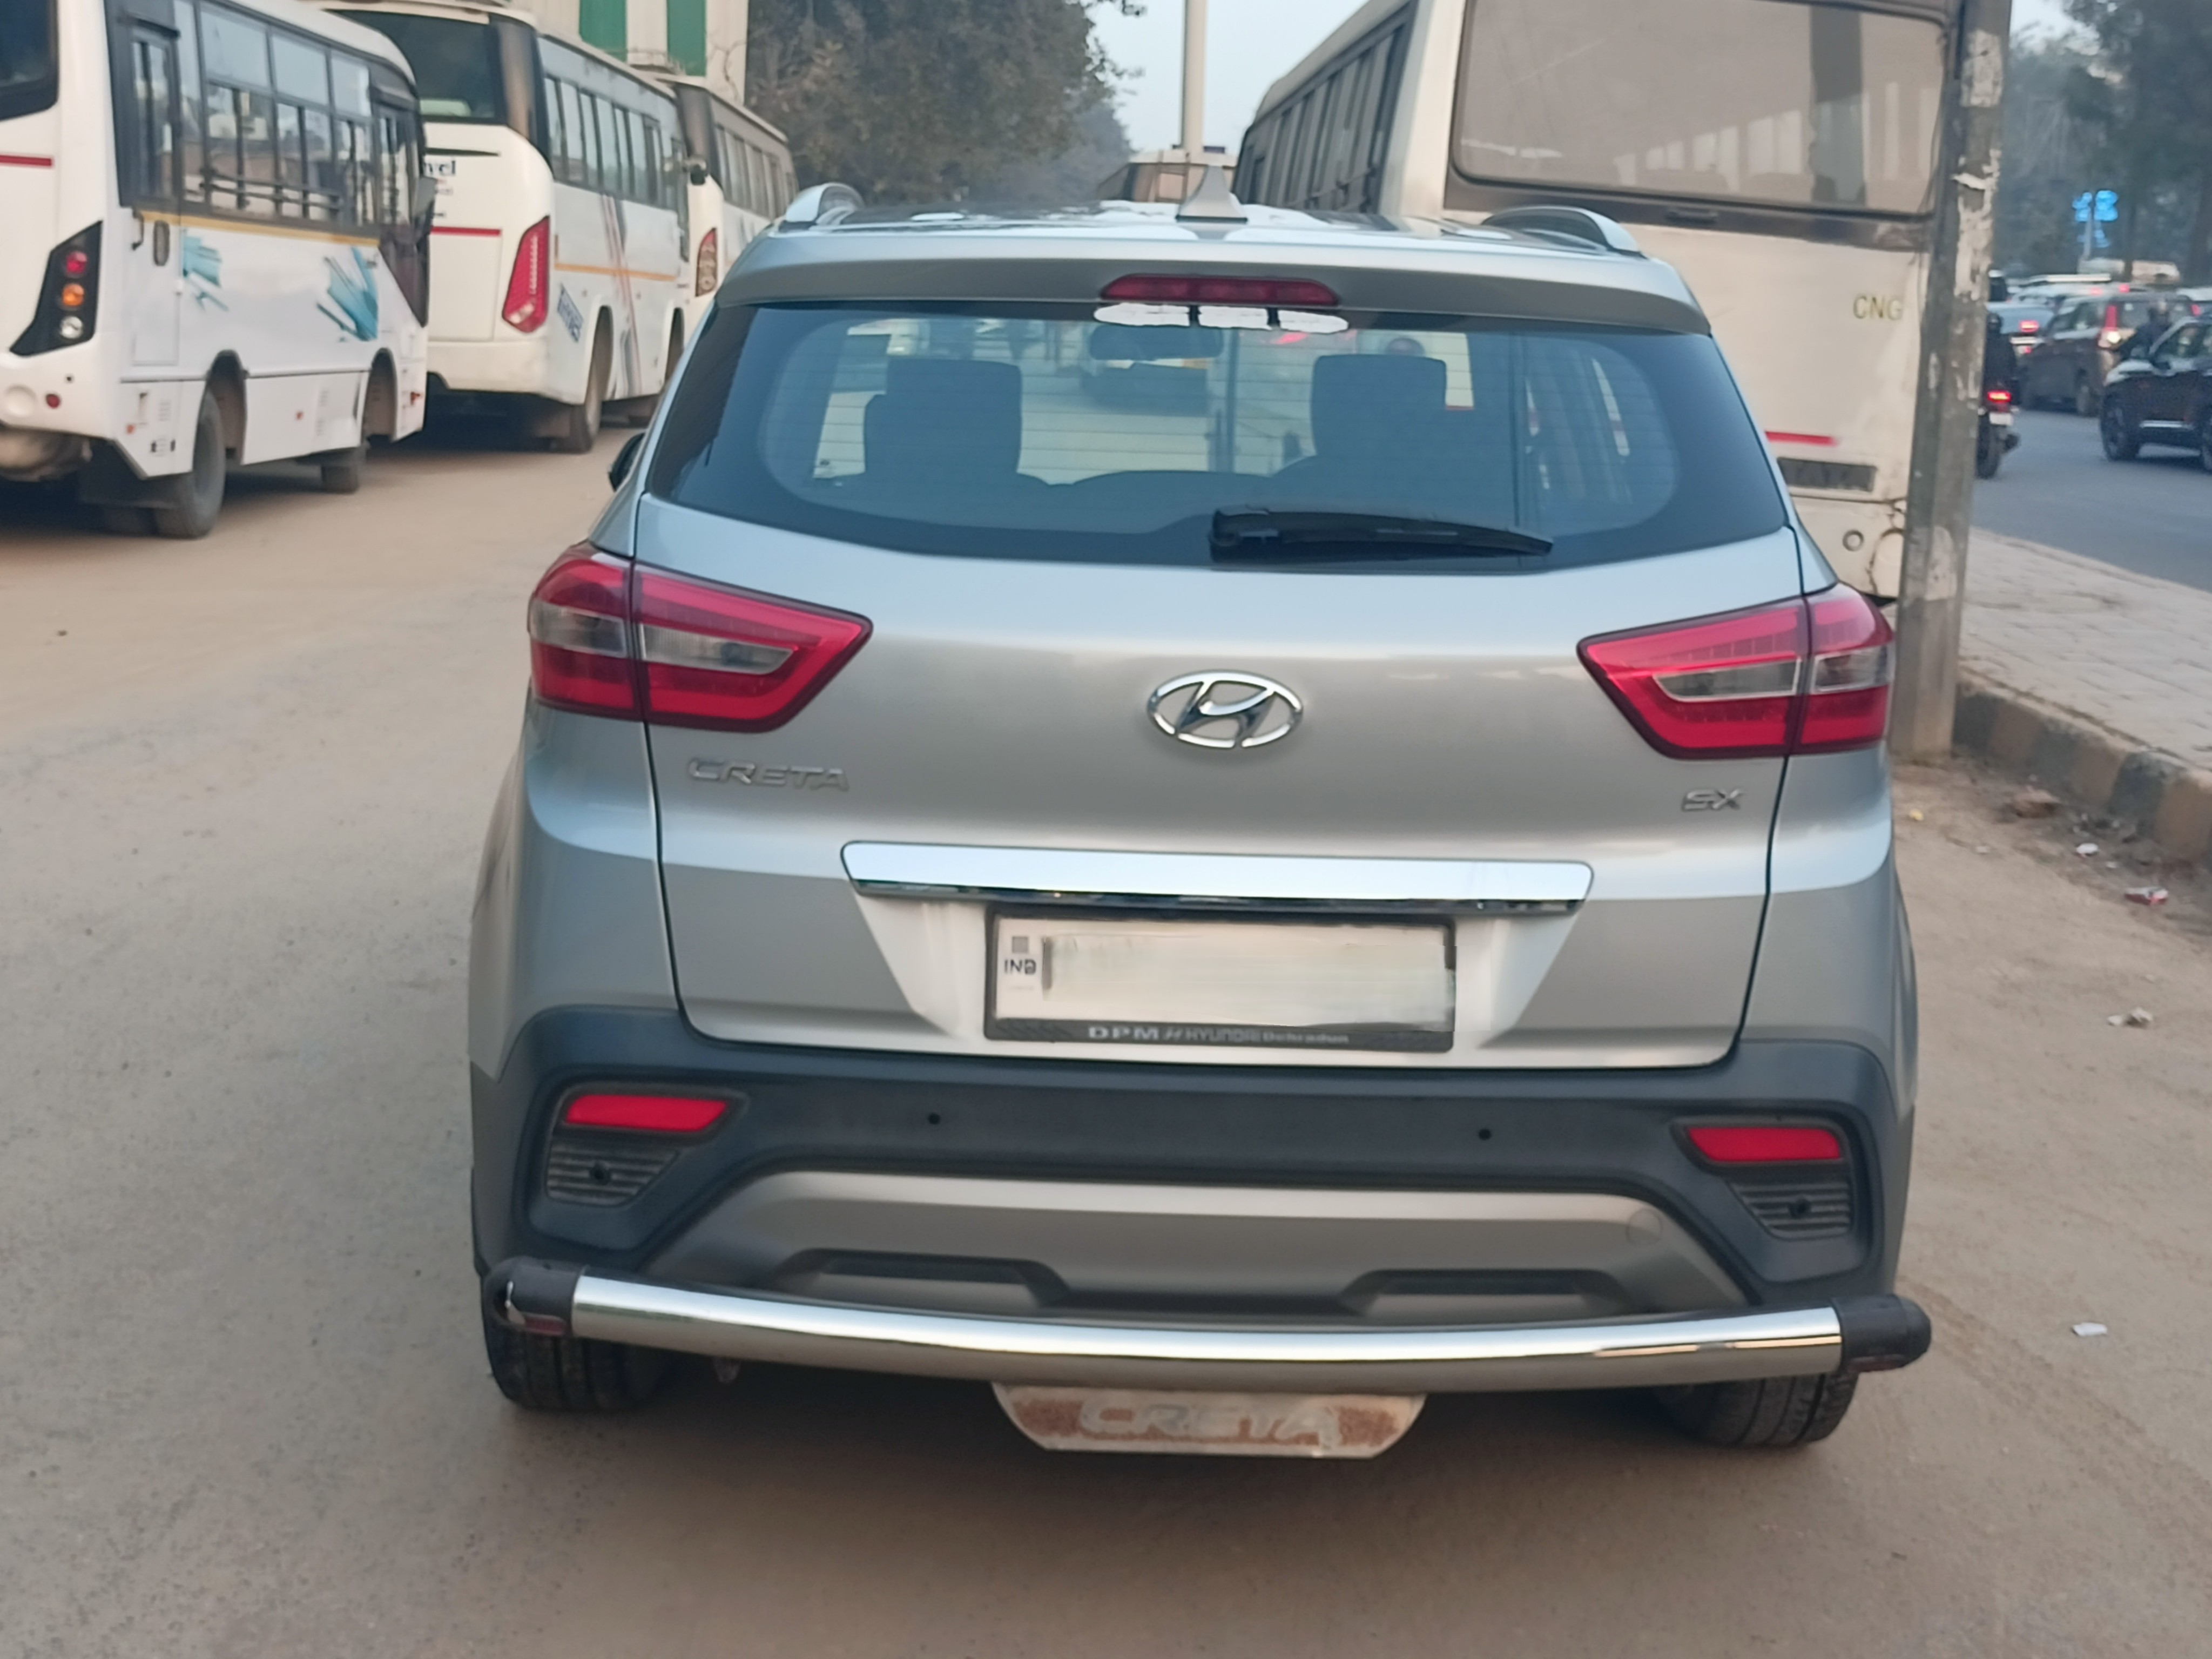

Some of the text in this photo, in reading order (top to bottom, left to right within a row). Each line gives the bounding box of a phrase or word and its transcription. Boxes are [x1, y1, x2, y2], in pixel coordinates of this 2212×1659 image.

[1853, 294, 1903, 321] CNG
[687, 758, 849, 792] CRETA
[1682, 787, 1742, 812] SX
[1004, 959, 1037, 975] IND
[1088, 1026, 1160, 1040] DPM
